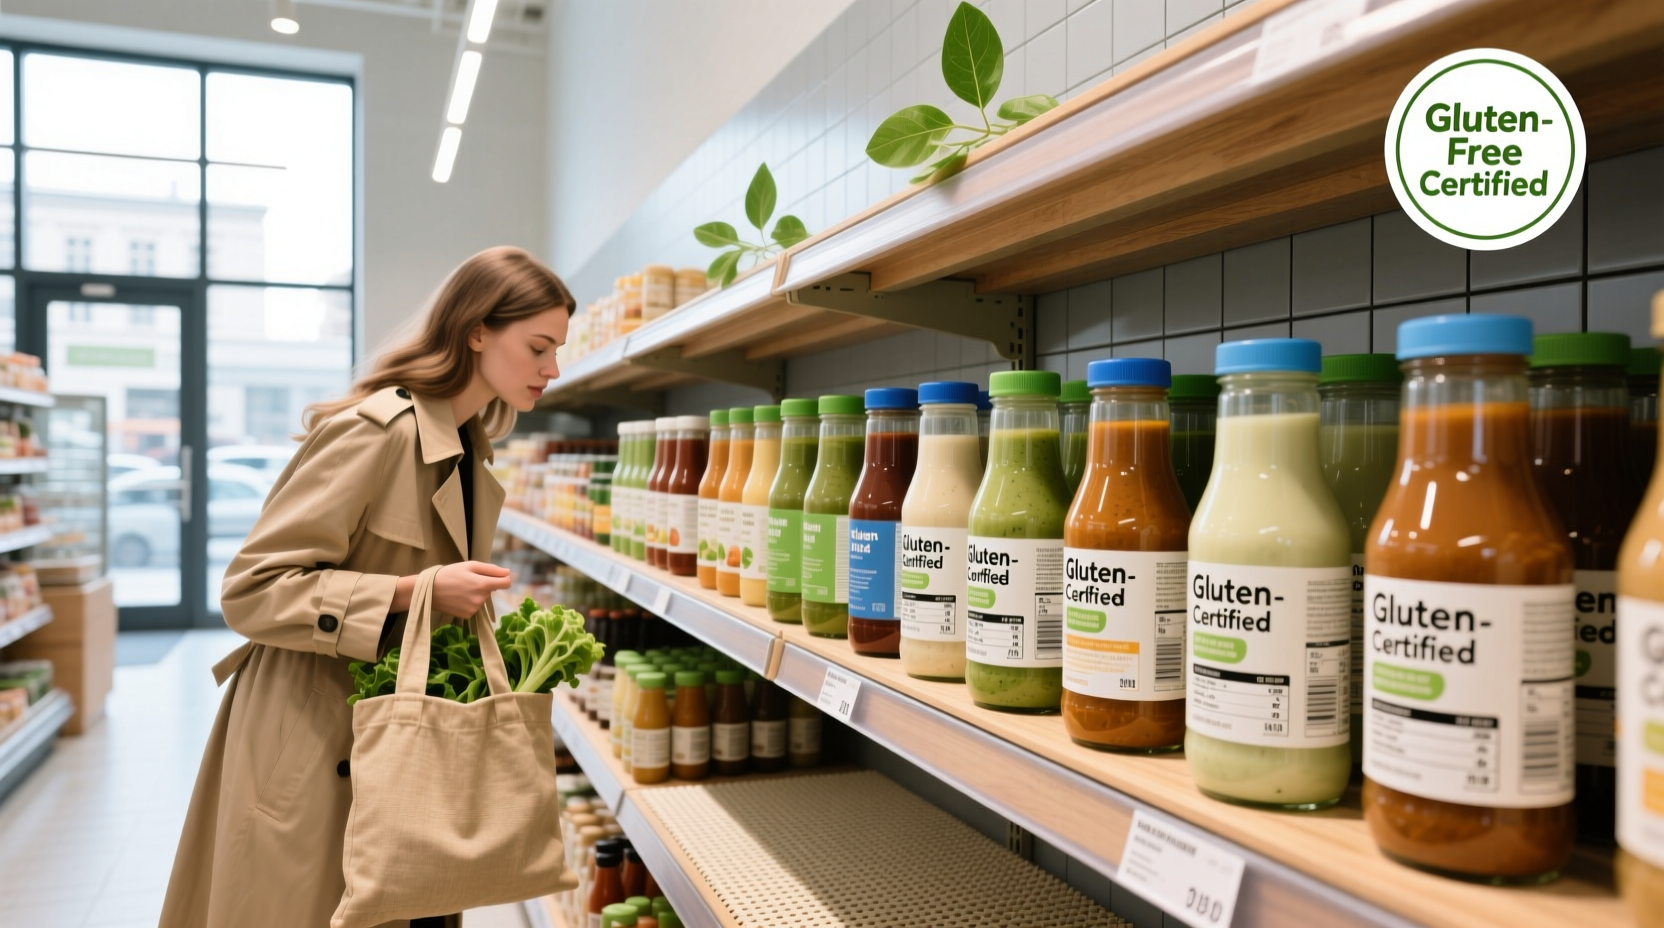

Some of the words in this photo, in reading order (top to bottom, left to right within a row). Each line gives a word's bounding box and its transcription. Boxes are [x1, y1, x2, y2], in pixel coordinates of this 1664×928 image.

[1066, 557, 1136, 584] Gluten-
[1193, 574, 1285, 606] Gluten-
[1193, 604, 1271, 633] Certified
[1373, 593, 1492, 632] Gluten-
[1372, 629, 1476, 665] Certified
